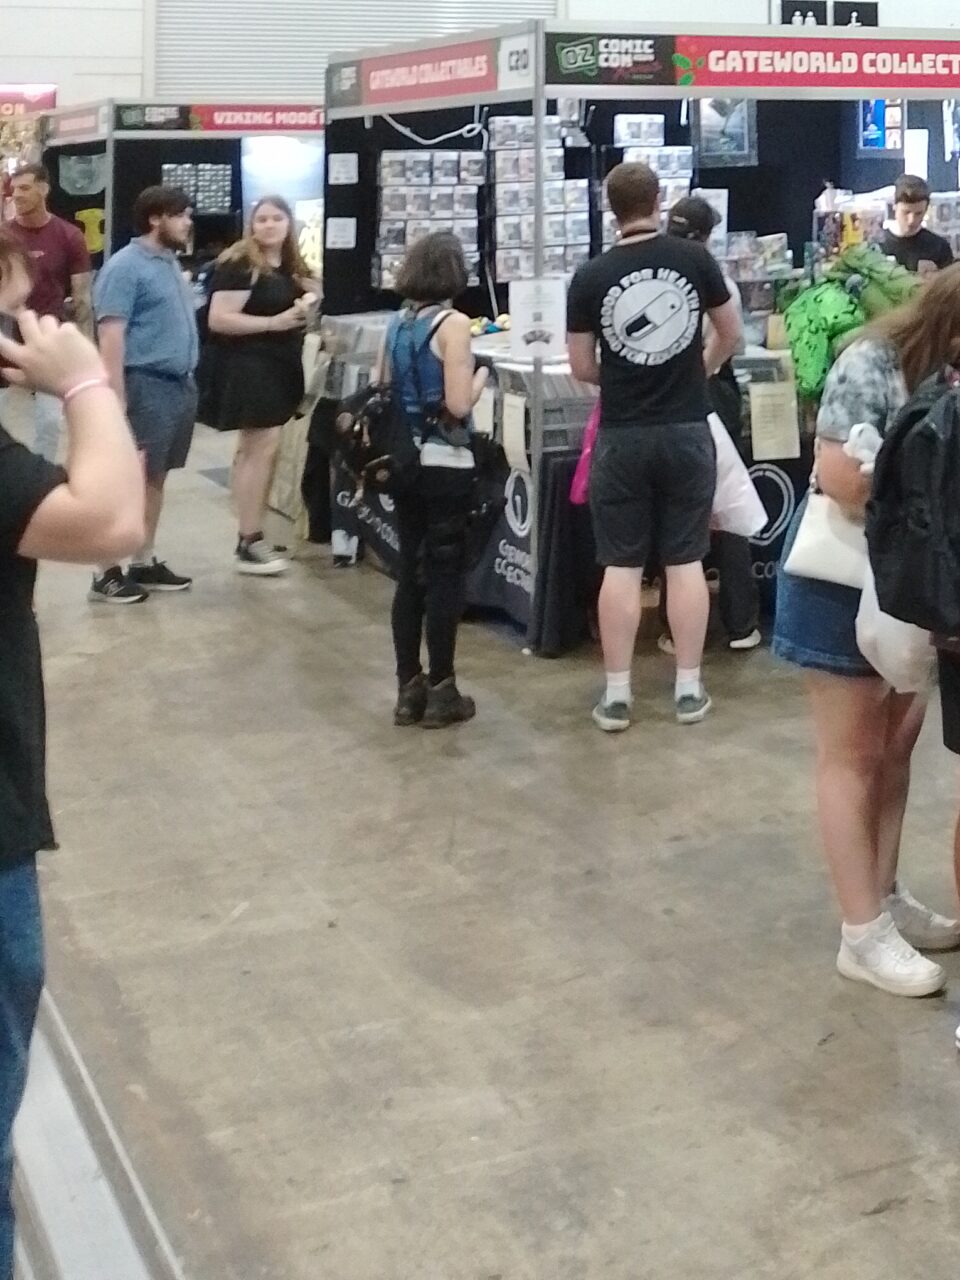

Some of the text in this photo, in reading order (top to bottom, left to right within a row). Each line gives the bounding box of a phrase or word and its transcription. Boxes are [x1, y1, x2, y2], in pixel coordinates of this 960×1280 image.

[561, 43, 596, 69] OZ
[599, 38, 655, 53] COMIC
[708, 50, 858, 73] GATEWORLD
[600, 285, 623, 327] GOOD
[619, 267, 654, 289] FOR
